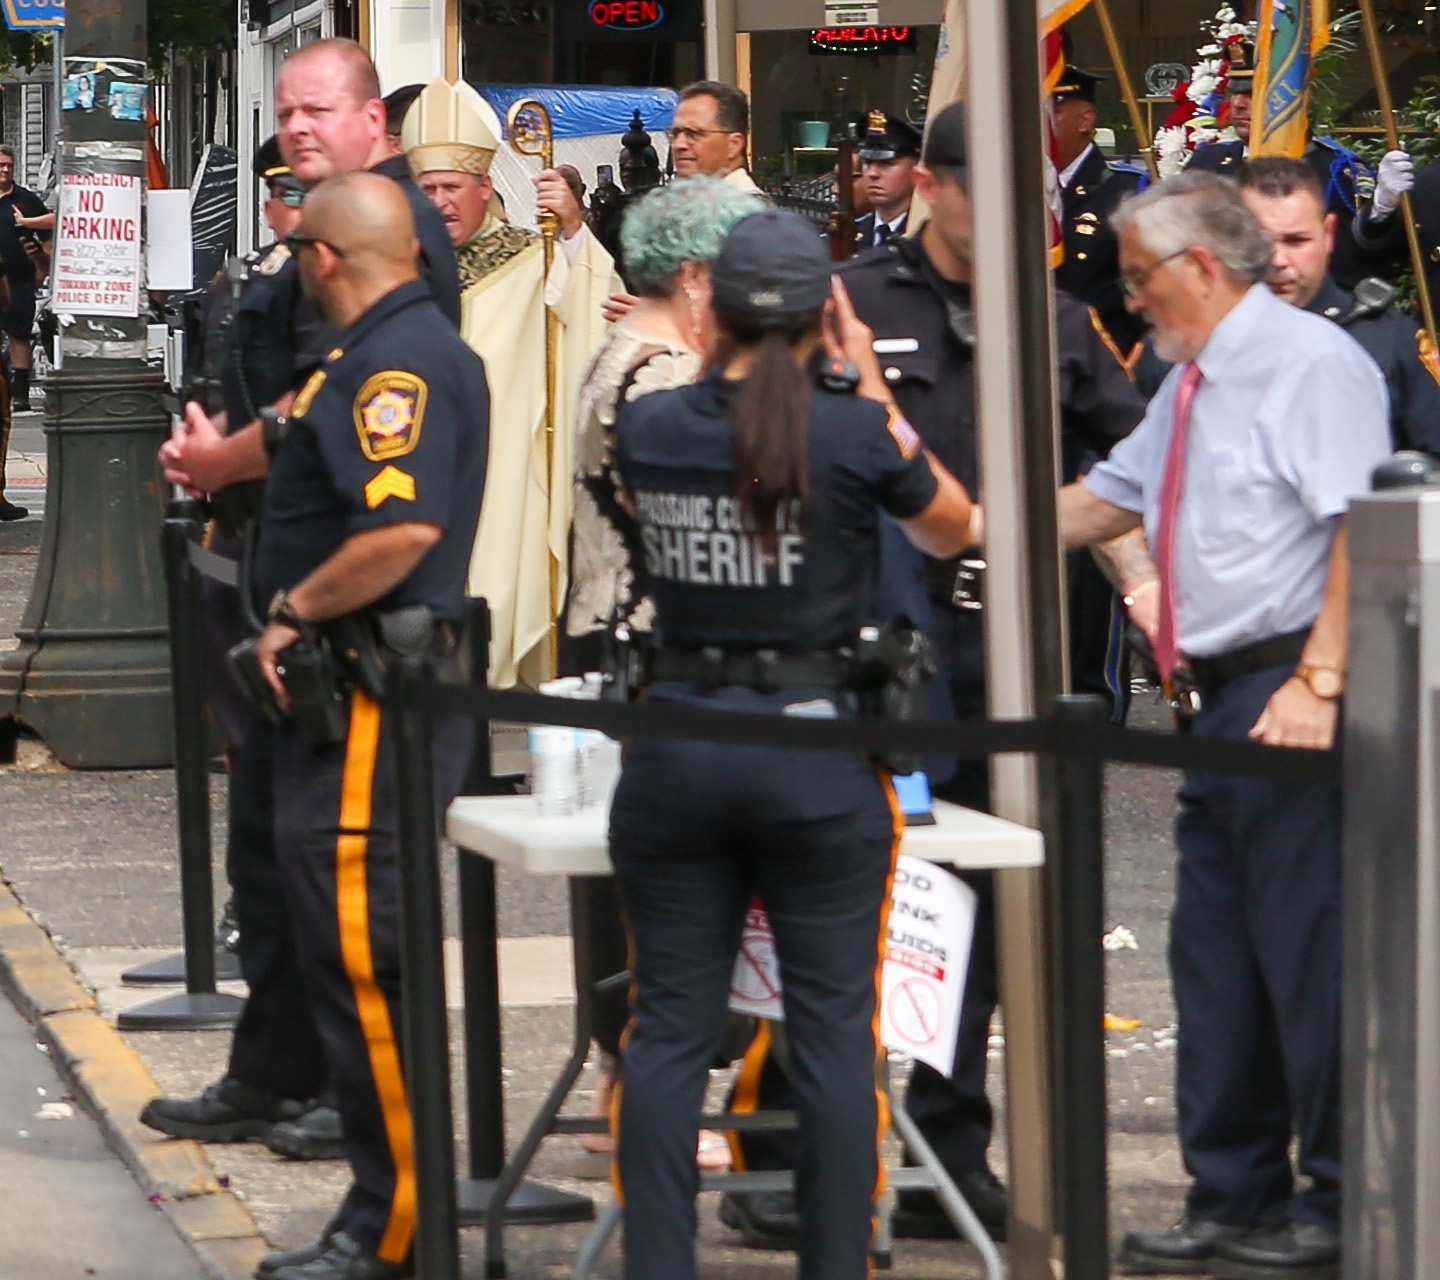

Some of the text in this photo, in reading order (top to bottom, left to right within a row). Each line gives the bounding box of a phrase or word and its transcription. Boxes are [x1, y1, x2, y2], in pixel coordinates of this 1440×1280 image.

[592, 0, 658, 24] OPEN
[79, 190, 104, 213] NO
[61, 216, 135, 241] PARKING
[56, 292, 90, 304] POLICE
[105, 281, 132, 292] ZONE
[641, 526, 804, 586] SHERIFF
